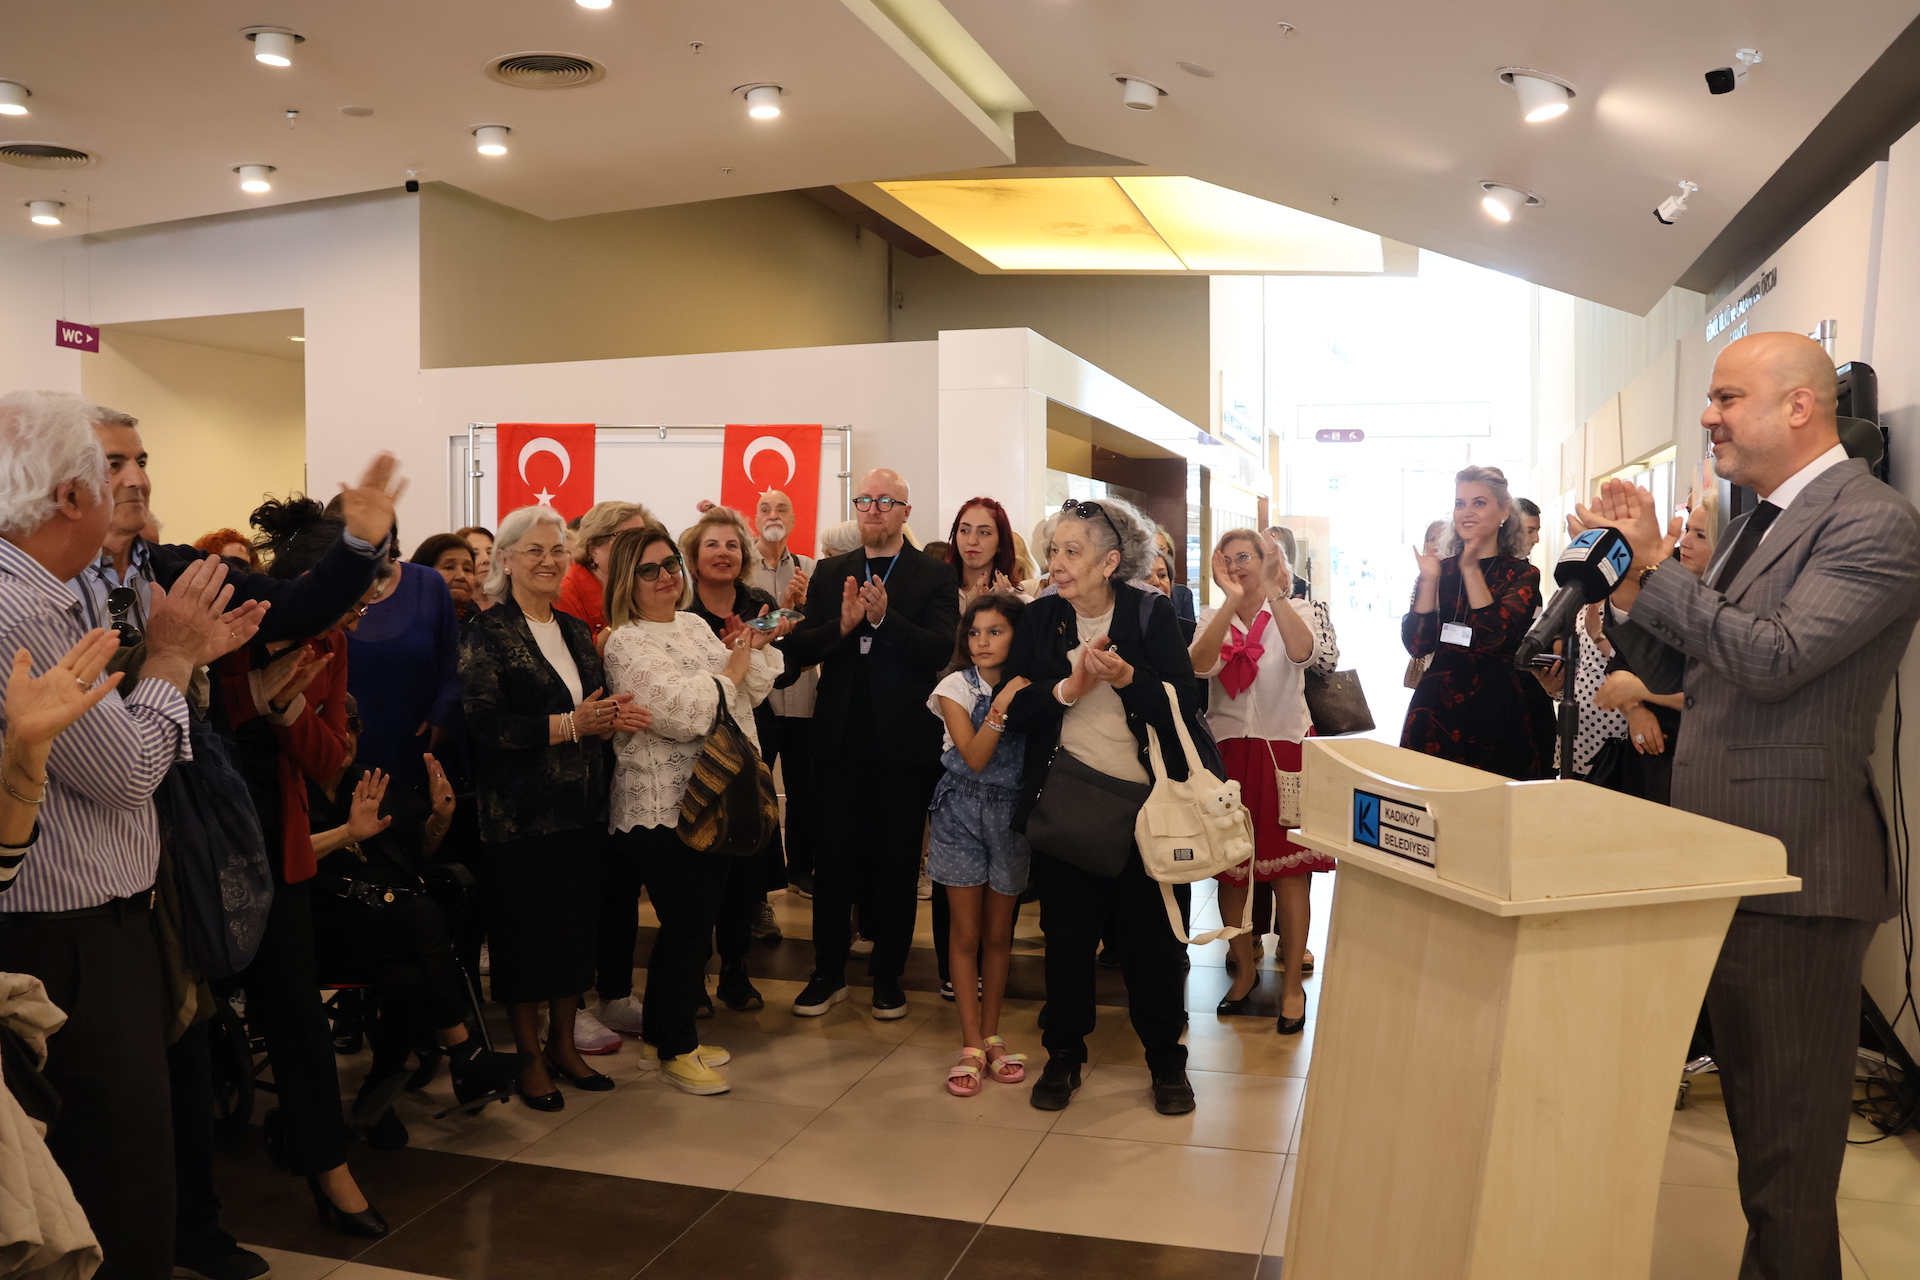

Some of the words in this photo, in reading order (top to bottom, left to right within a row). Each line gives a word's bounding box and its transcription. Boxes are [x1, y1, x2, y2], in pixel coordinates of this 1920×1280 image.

[62, 327, 83, 344] WC
[1384, 807, 1421, 827] KADIKÖY
[1384, 833, 1430, 858] BELEDİYESİ
